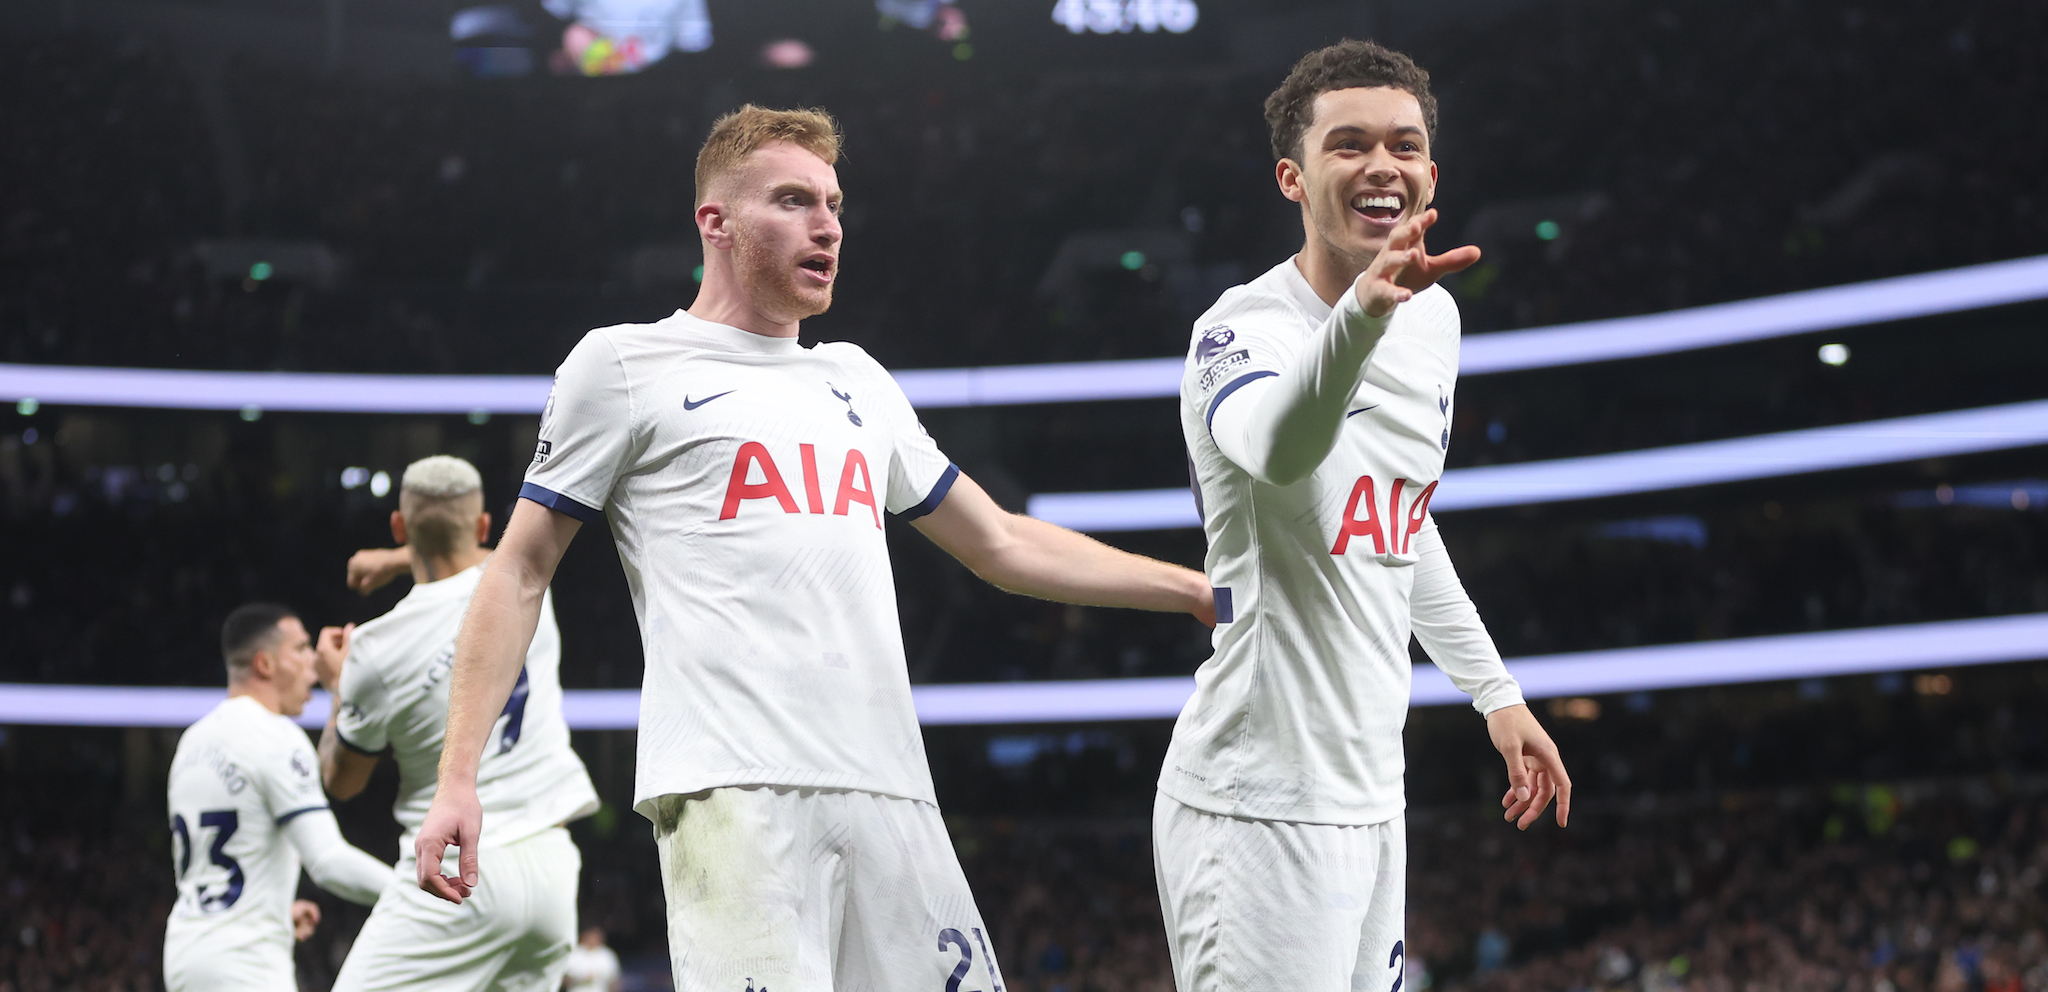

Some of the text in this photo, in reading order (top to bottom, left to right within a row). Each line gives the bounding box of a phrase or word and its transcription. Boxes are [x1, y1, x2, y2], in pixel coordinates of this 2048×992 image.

[1209, 353, 1242, 376] room
[719, 441, 881, 530] AIA
[938, 928, 1002, 992] 21
